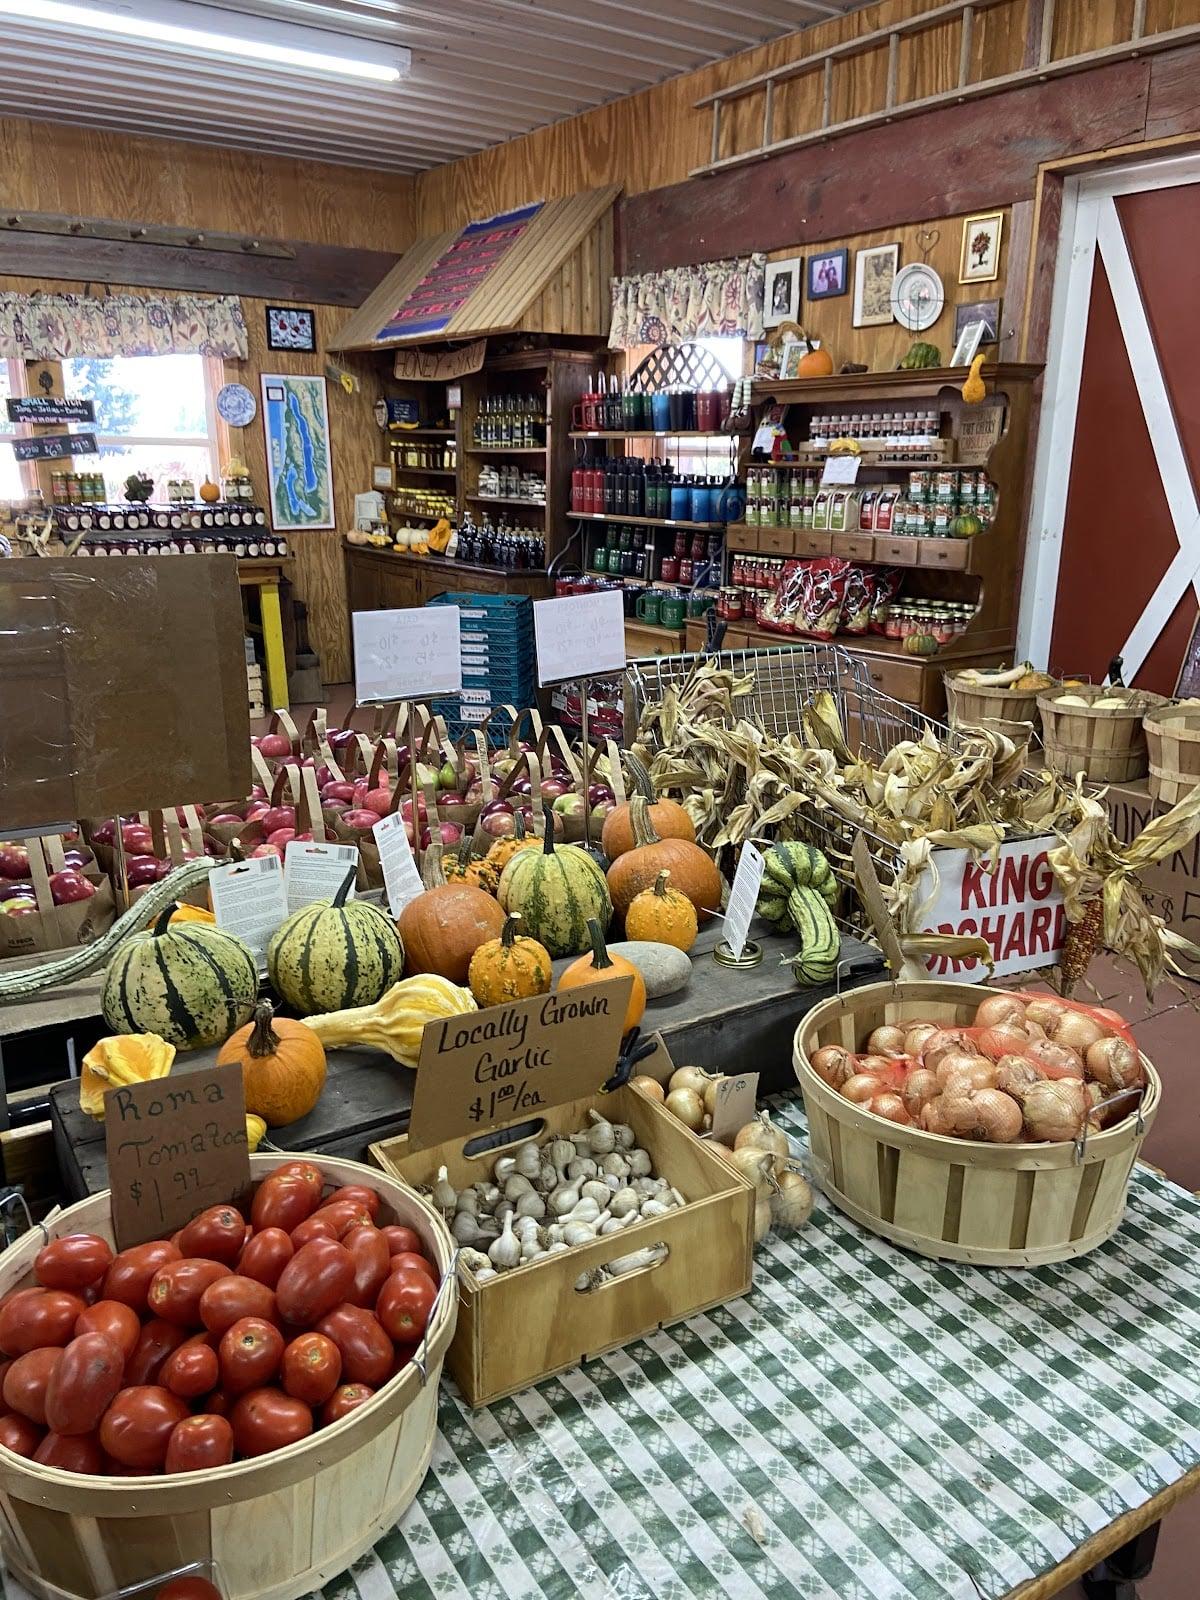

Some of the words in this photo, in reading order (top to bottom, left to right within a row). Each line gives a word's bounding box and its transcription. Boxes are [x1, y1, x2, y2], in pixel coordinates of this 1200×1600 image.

[396, 351, 446, 378] HONEY
[961, 851, 1054, 911] KING
[438, 1009, 528, 1054] Locally
[540, 996, 610, 1026] Grown
[475, 1047, 552, 1084] Garlic
[113, 1083, 225, 1121] Roma
